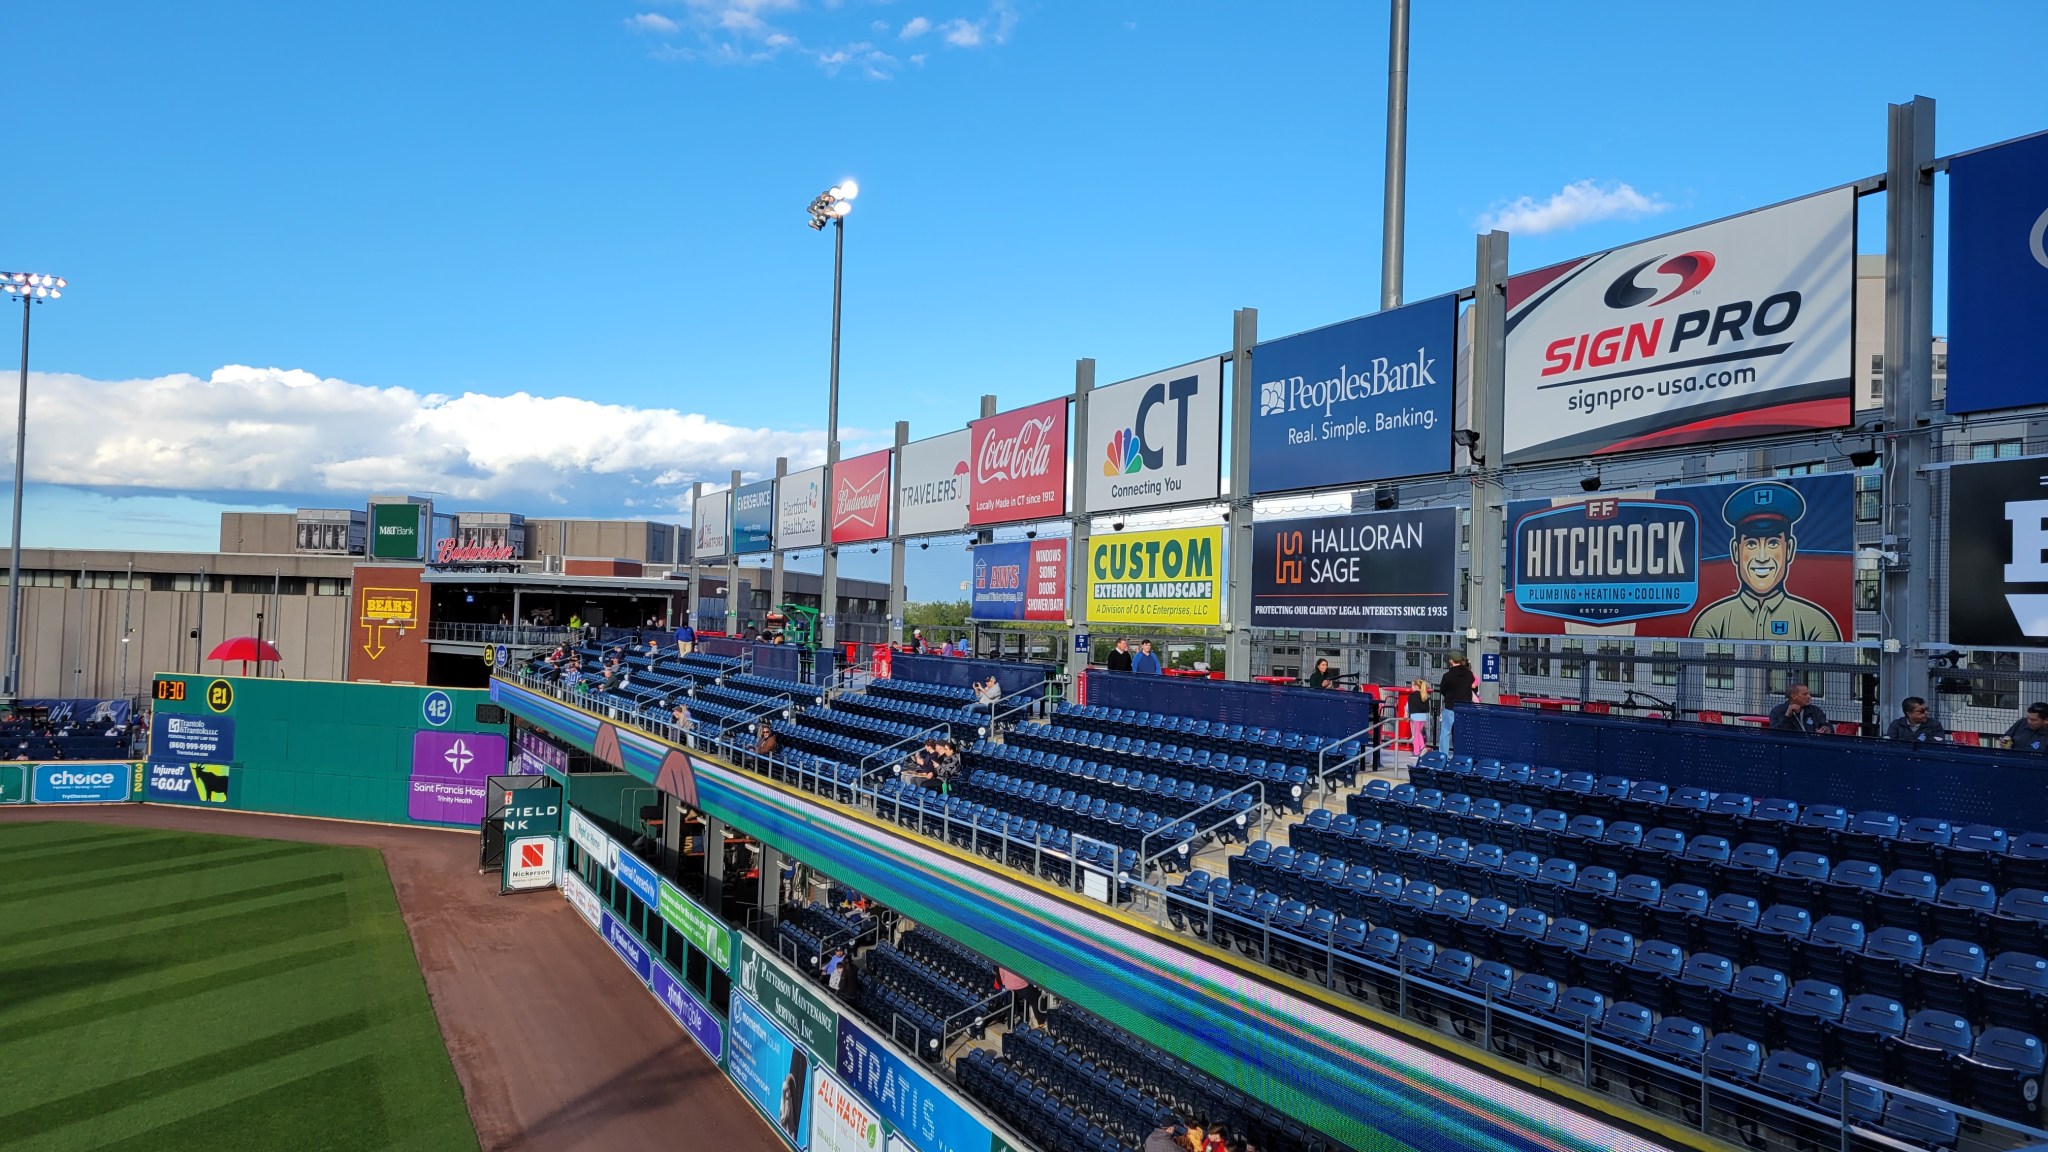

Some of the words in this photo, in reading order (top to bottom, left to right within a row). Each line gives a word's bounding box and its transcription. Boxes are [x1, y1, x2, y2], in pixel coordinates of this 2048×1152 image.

[1541, 317, 1664, 377] SIGN
[1669, 290, 1802, 354] PRO
[1288, 346, 1436, 418] PeoplesBank
[1568, 366, 1755, 414] signpro-usa.com
[1135, 374, 1198, 470] CT
[1288, 423, 1317, 445] Real.
[1322, 416, 1370, 440] Simple.
[1375, 407, 1438, 430] Banking.
[977, 414, 1056, 484] Coca-Cola
[901, 479, 957, 507] TRAVELERS
[1111, 480, 1162, 498] Connecting
[1164, 477, 1182, 491] You
[783, 497, 808, 517] Hartford
[838, 489, 881, 514] Budweiser
[976, 499, 994, 511] Locally
[995, 498, 1009, 508] Made
[1010, 496, 1017, 506] in
[1017, 495, 1026, 506] CT
[1026, 493, 1041, 504] since
[1042, 491, 1055, 502] 1912
[1311, 522, 1423, 554] HALLORAN
[436, 537, 513, 563] Budweiser
[1035, 549, 1062, 562] WINDOWS
[1526, 521, 1685, 577] HITCHCOCK
[1094, 537, 1213, 581] CUSTOM
[990, 565, 1020, 589] AWS
[1039, 565, 1057, 579] SIDING
[1310, 557, 1360, 584] SAGE
[1038, 582, 1056, 595] DOORS
[1094, 583, 1142, 598] EXTERIOR
[1145, 582, 1212, 598] LANDSCAPE
[1529, 589, 1576, 600] PLUMBING
[1584, 588, 1626, 600] HEATING
[1634, 587, 1680, 600] COOLING
[367, 599, 412, 613] BEAR'S
[1027, 598, 1064, 611] SHOWER/BATH
[1096, 605, 1101, 613] A
[1101, 604, 1124, 614] Division
[1125, 604, 1133, 614] of
[1133, 605, 1139, 614] O
[1140, 605, 1145, 614] &
[1146, 605, 1151, 614] C
[1152, 605, 1191, 617] Enterprises,
[1193, 605, 1208, 616] LLC
[1255, 606, 1293, 615] PROTECTING
[1294, 606, 1308, 615] OUR
[1309, 606, 1338, 616] CLIENTS'
[1339, 606, 1361, 616] LEGAL
[1362, 606, 1402, 616] INTERESTS
[1403, 607, 1425, 616] SINCE
[1427, 607, 1448, 616] 1935
[158, 681, 185, 700] 0:30
[212, 687, 227, 704] 21
[428, 699, 447, 718] 42
[180, 719, 205, 728] Trantolo
[186, 742, 216, 752] 999-9999
[50, 770, 115, 785] choice
[153, 764, 185, 776] Injured?
[414, 782, 435, 793] Saint
[435, 784, 464, 795] Francis
[465, 785, 486, 797] Hosp
[437, 795, 453, 806] Trinity
[454, 795, 473, 805] Health
[505, 806, 558, 818] FIELD
[503, 820, 529, 831] NK
[512, 869, 550, 878] Nickerson
[667, 982, 683, 1015] xfinity
[682, 1001, 702, 1031] mobile
[761, 961, 791, 998] PATTERSON
[791, 984, 833, 1033] MAINTENANCE
[842, 1033, 935, 1141] STRATIS
[817, 1079, 833, 1109] ALL
[836, 1091, 868, 1139] WASTE
